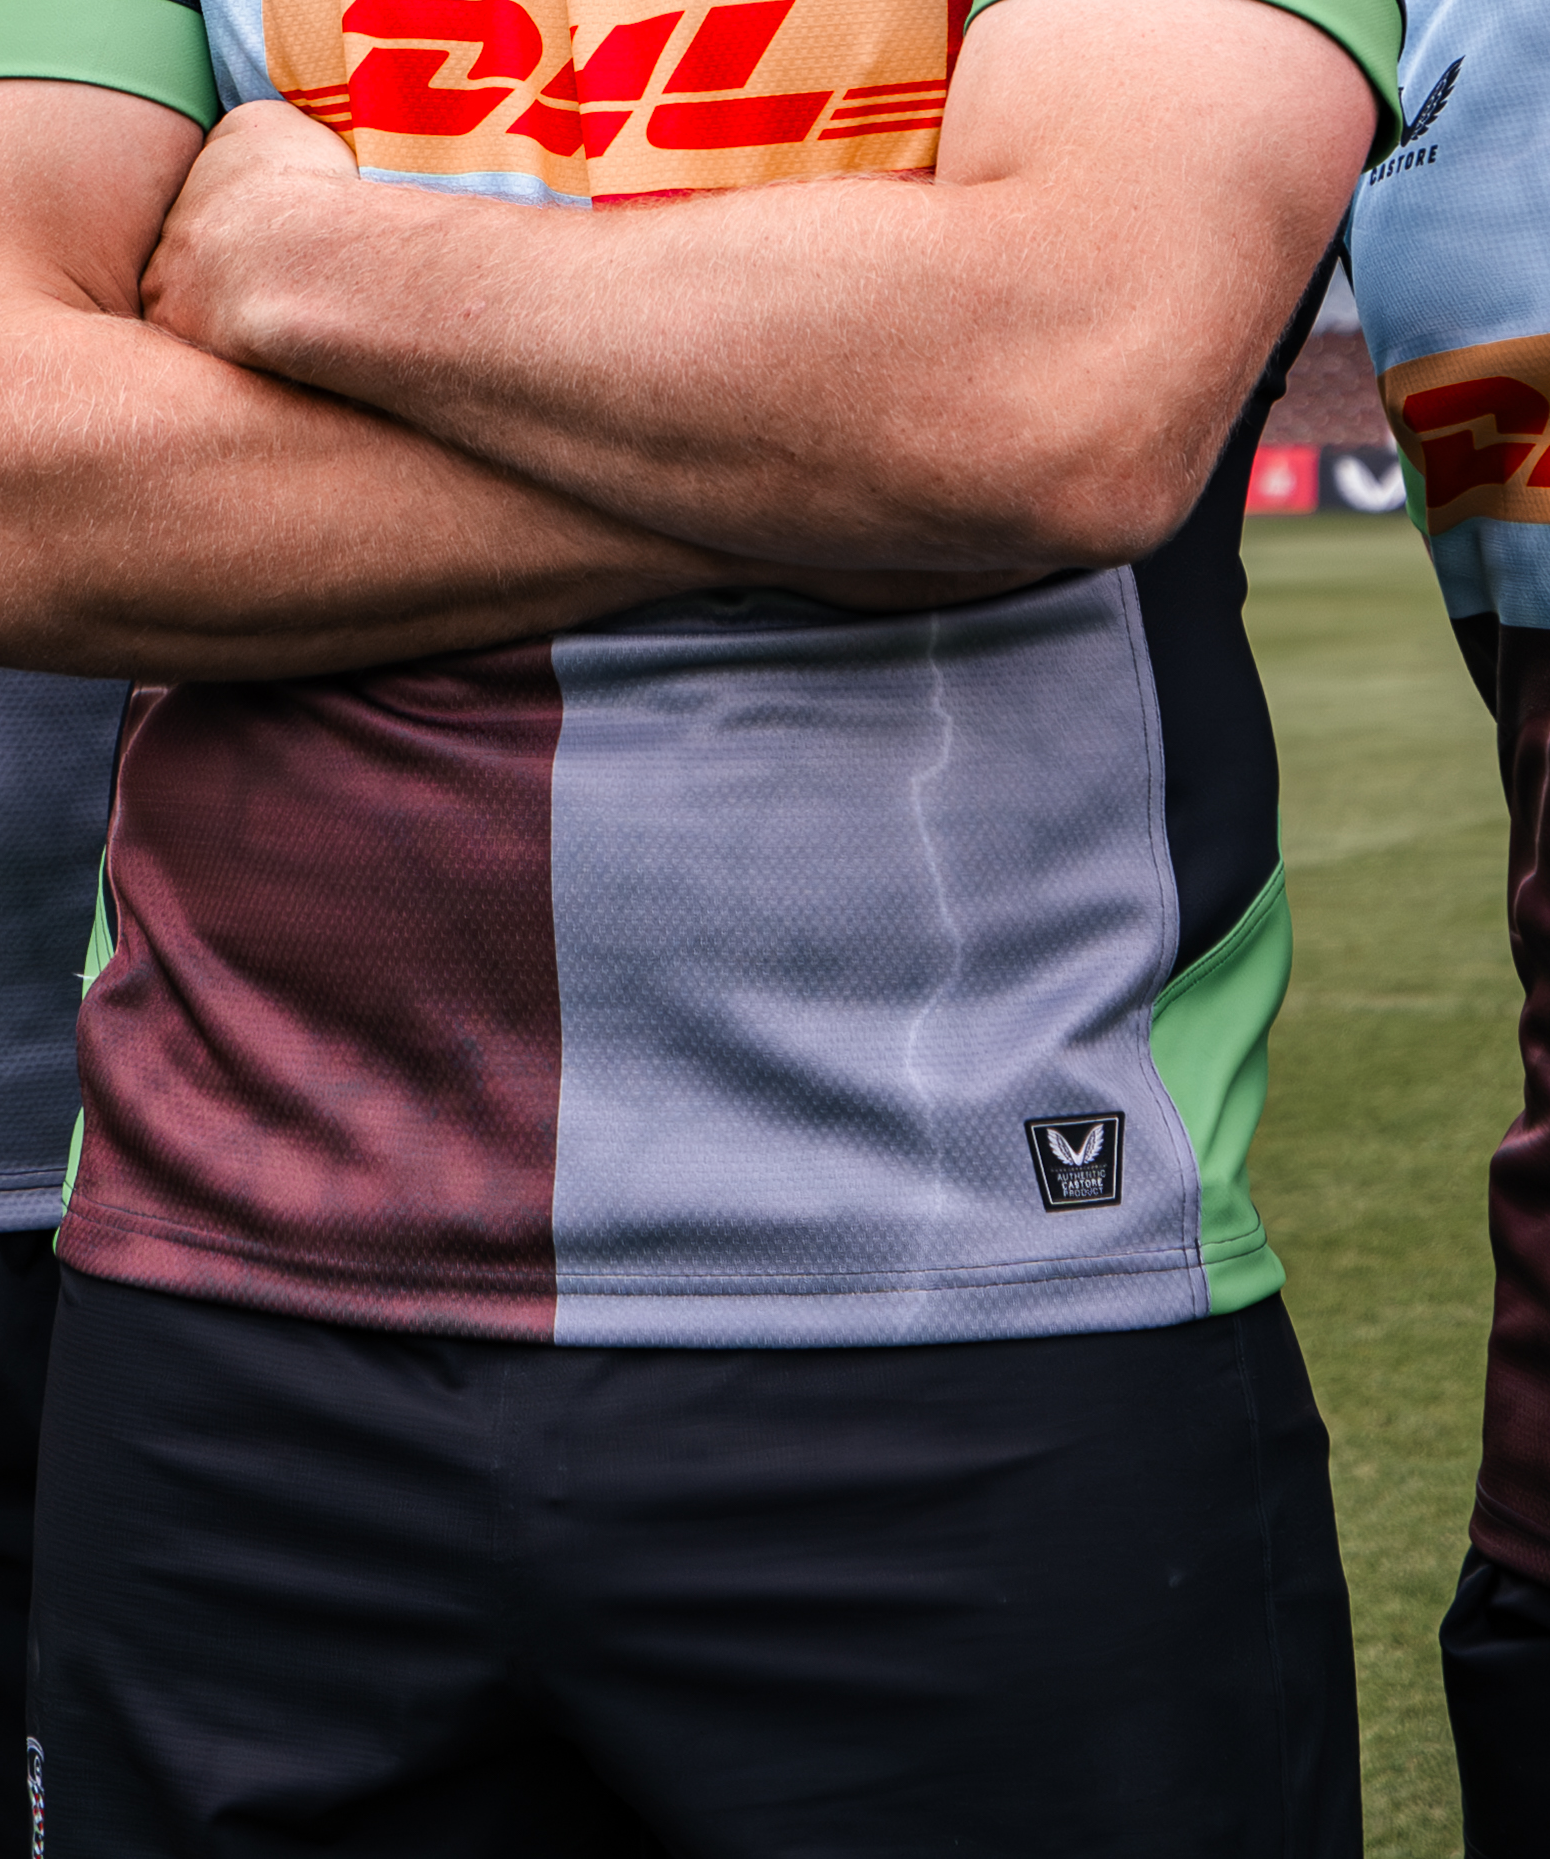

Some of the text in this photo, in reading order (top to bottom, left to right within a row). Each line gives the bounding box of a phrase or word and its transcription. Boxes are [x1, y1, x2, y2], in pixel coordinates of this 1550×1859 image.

[1369, 144, 1439, 187] CASTORE
[1057, 1169, 1107, 1182] AUTHENTIC
[1061, 1178, 1104, 1190] CASTORE
[1063, 1187, 1104, 1198] PRODUCT
